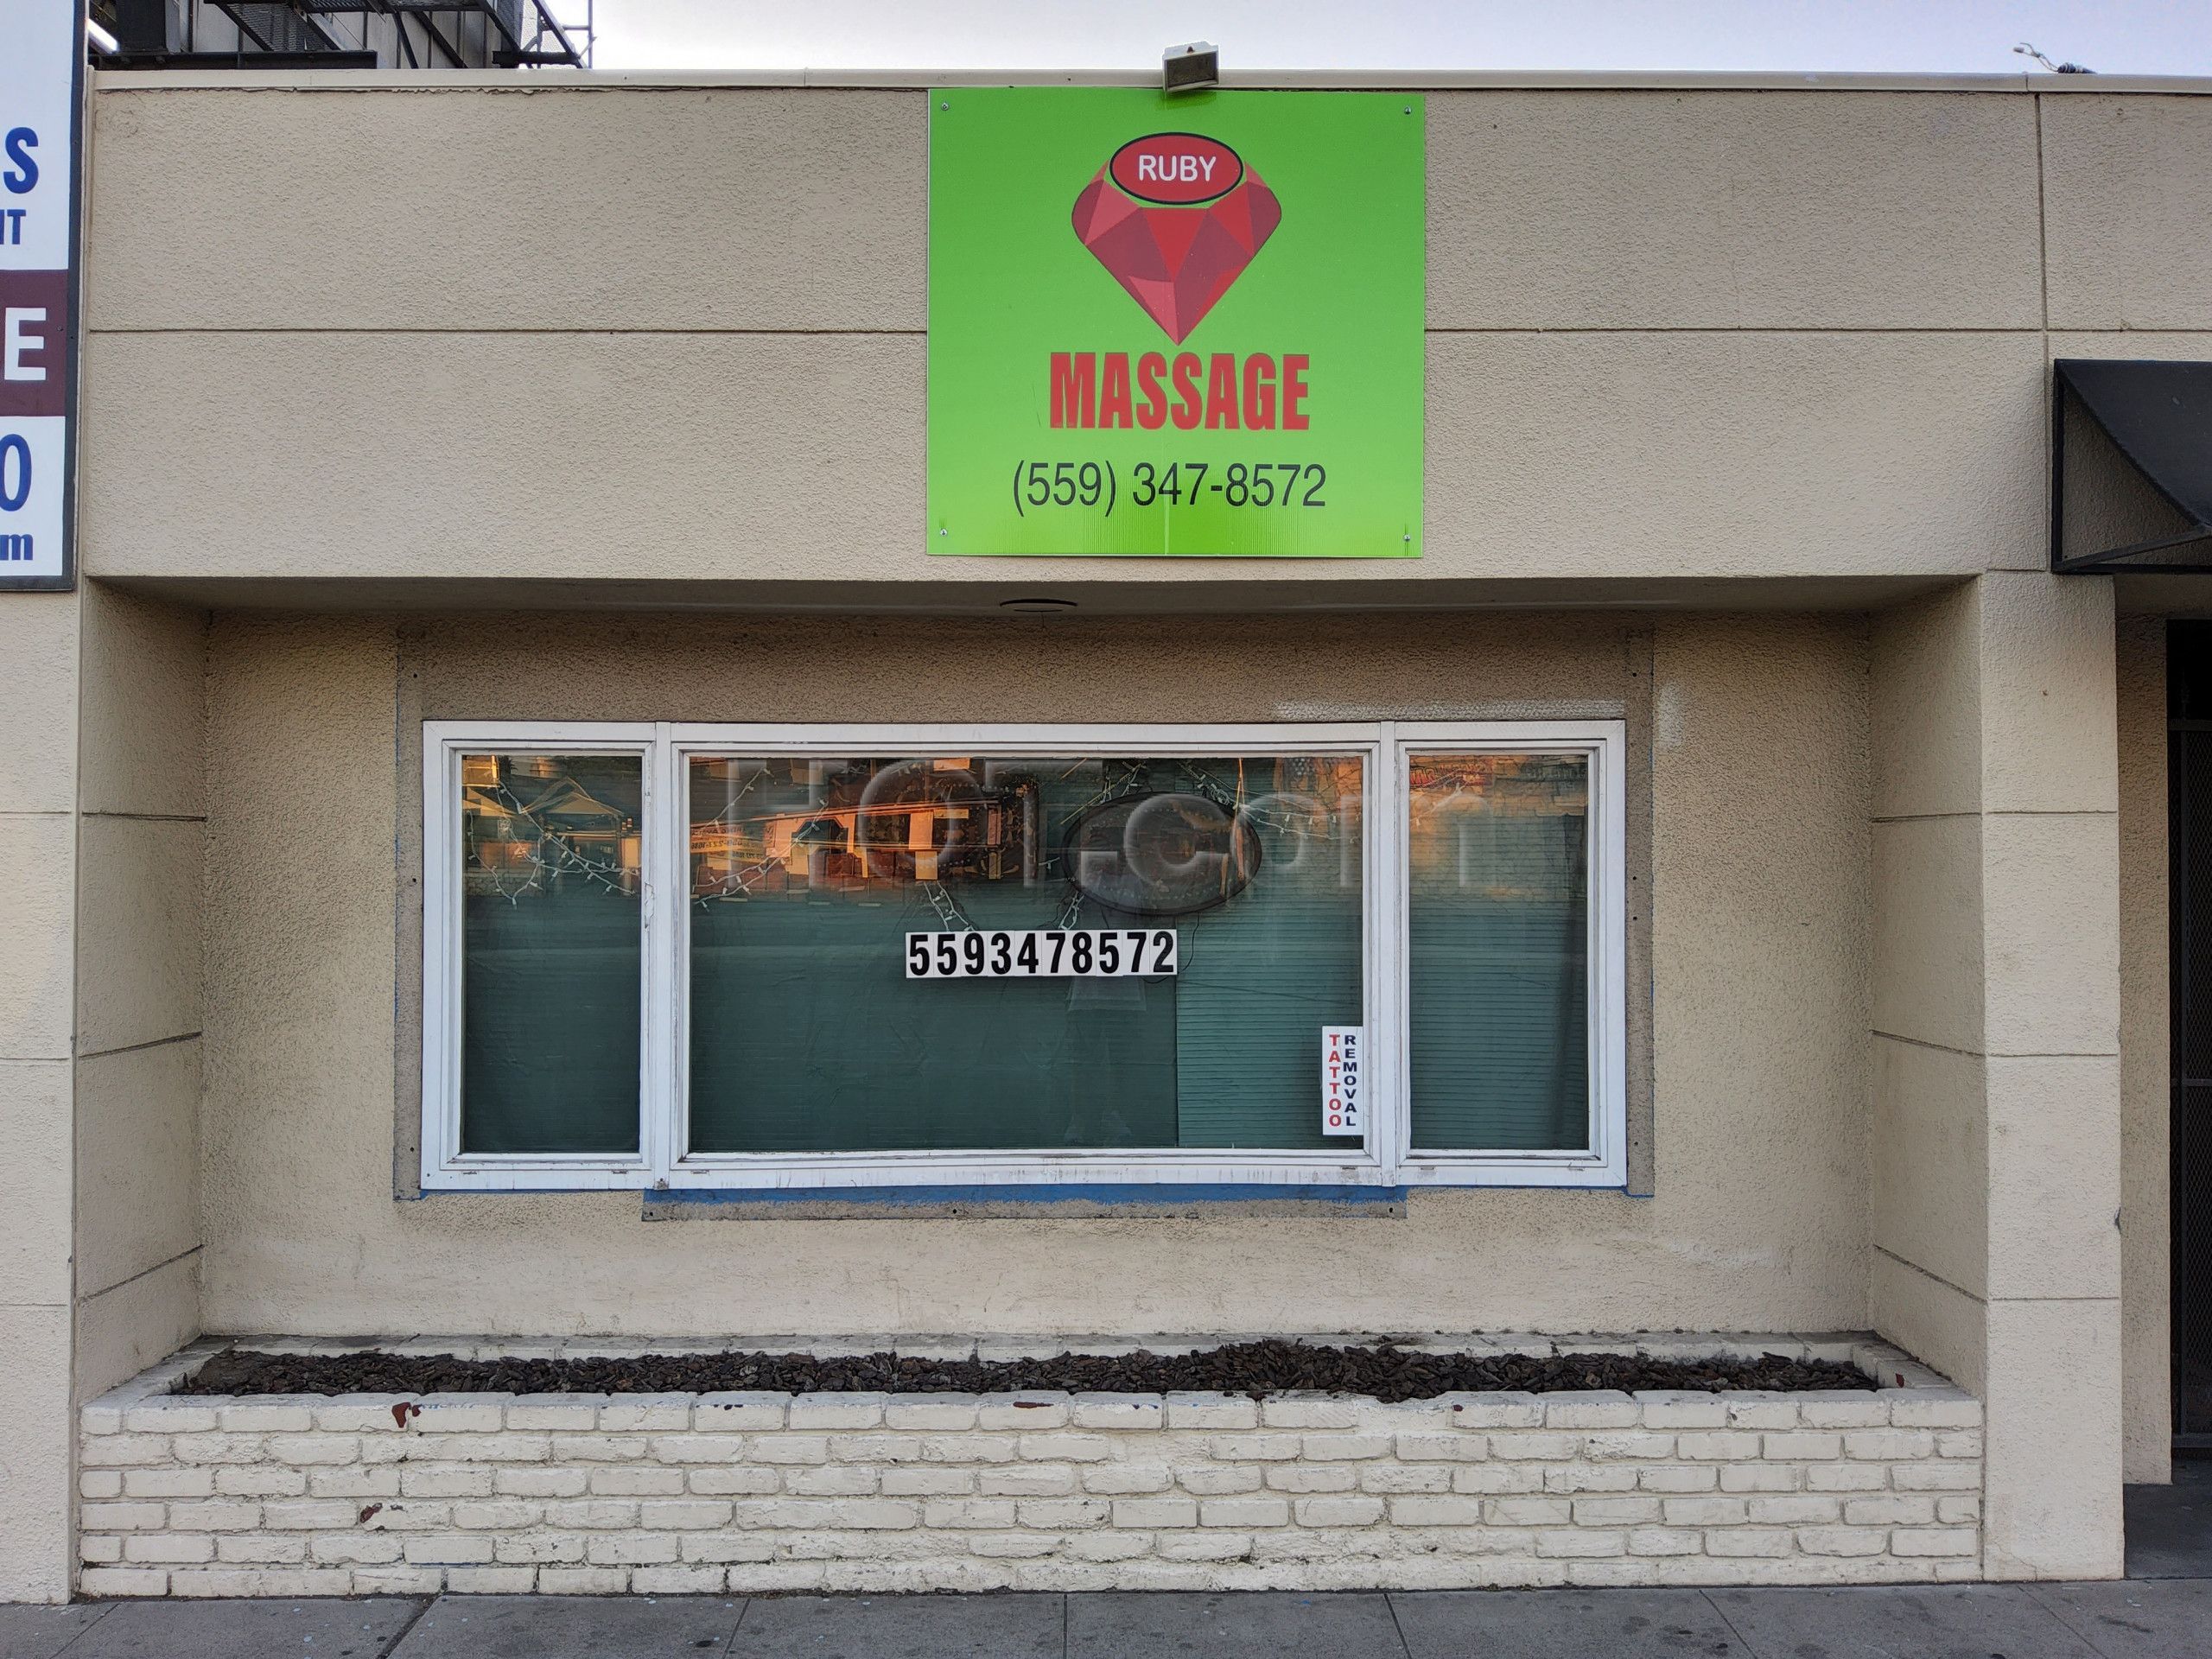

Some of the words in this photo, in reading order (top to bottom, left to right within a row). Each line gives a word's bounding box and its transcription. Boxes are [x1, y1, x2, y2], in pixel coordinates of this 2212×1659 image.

[3, 126, 39, 194] S
[1138, 155, 1217, 181] RUBY
[0, 208, 27, 245] T
[4, 307, 47, 381] E
[1049, 351, 1310, 430] MASSAGE
[1013, 459, 1116, 518] (559)
[1132, 461, 1327, 507] 347-8572
[909, 930, 1174, 976] 5593478572
[1328, 1033, 1342, 1127] TATTOO
[1343, 1034, 1357, 1127] REMOVAL
